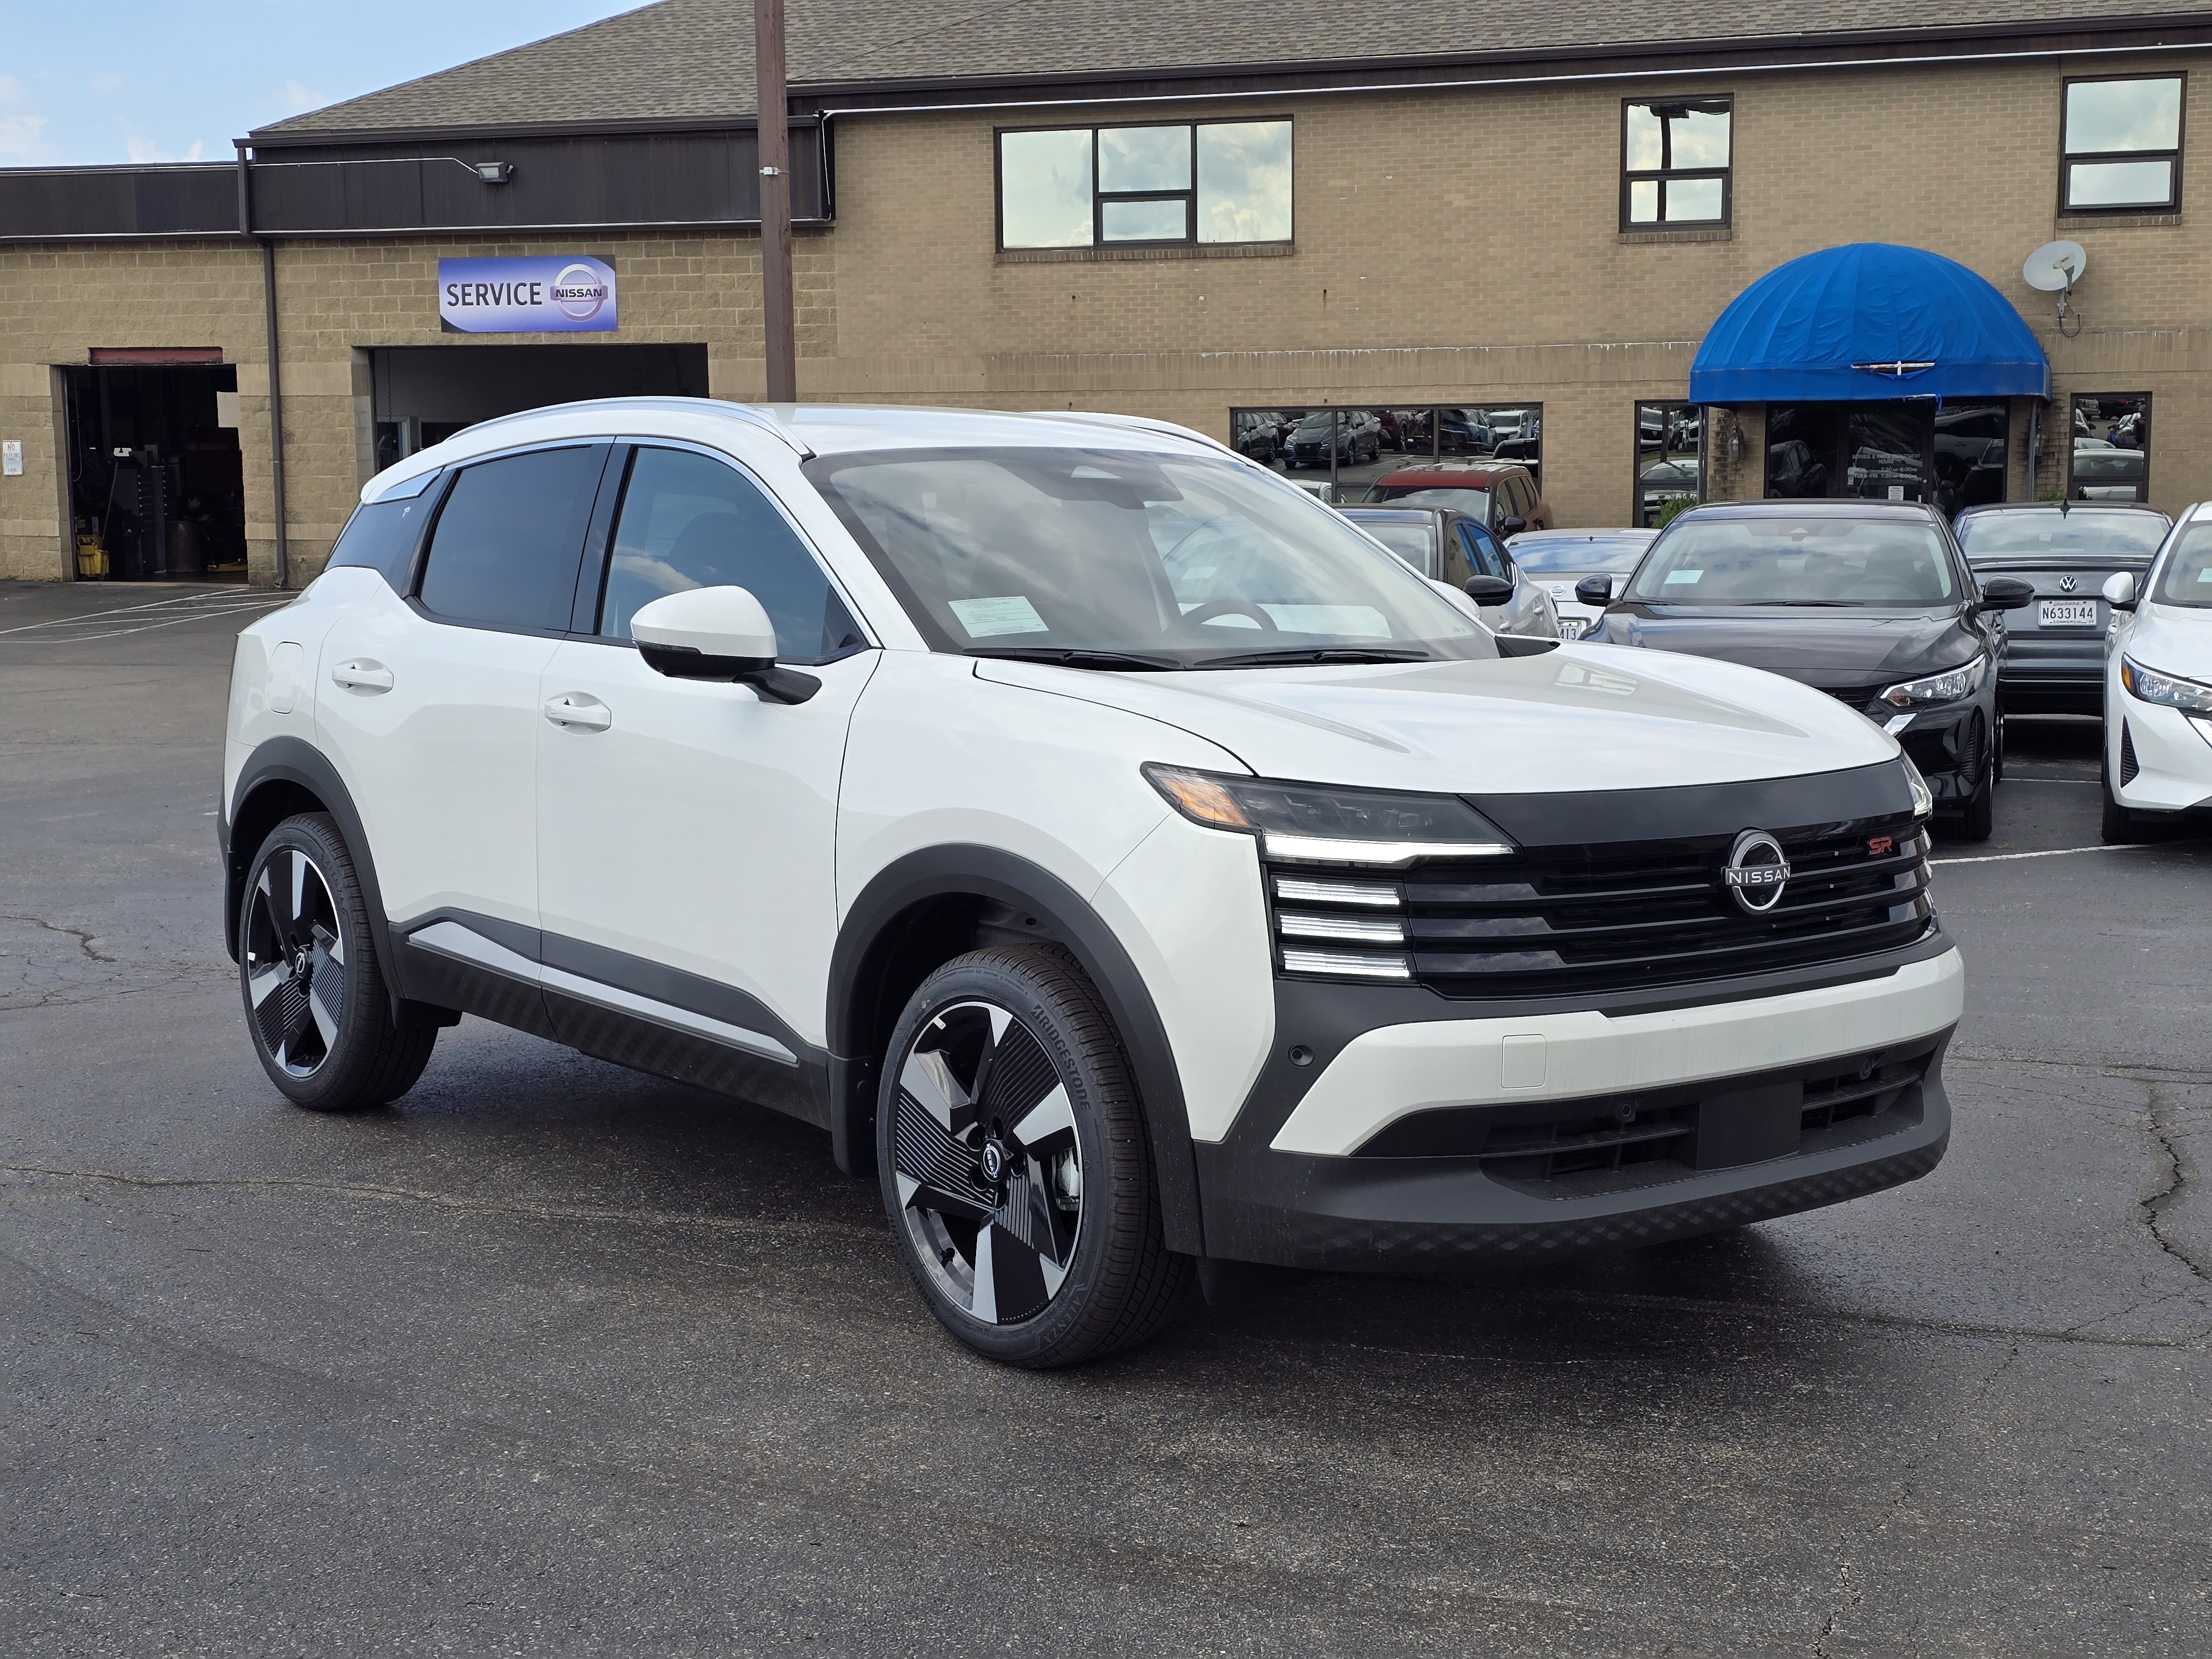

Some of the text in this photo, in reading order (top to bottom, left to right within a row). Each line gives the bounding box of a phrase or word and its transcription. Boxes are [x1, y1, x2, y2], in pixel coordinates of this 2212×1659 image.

[446, 282, 542, 306] SERVICE
[555, 288, 603, 298] NISSAN
[2042, 607, 2093, 619] N633144
[1869, 836, 1892, 855] SR
[325, 860, 345, 904] ALENZA
[1729, 867, 1791, 884] NISSAN
[1030, 1004, 1091, 1111] BRIDGESTONE
[1043, 1295, 1082, 1343] ALENZA
